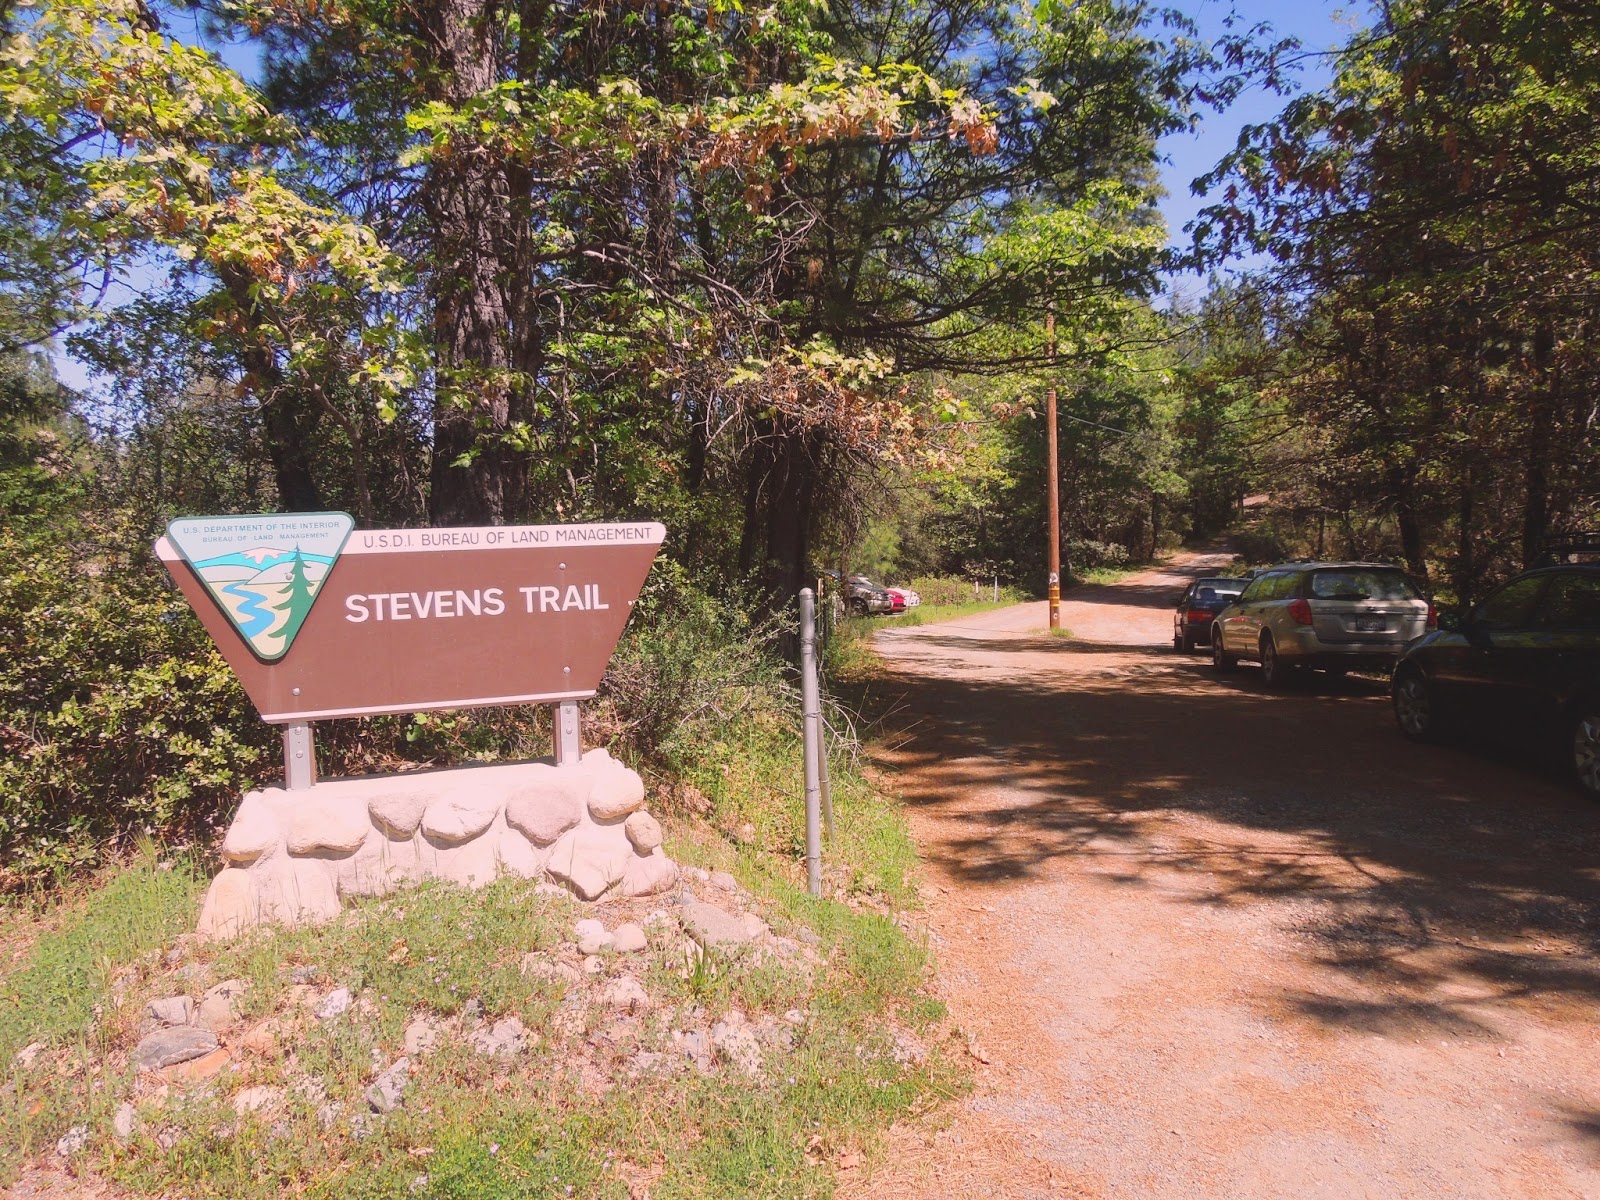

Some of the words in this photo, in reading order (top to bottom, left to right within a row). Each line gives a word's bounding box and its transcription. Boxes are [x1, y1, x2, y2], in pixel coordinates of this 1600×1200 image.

[183, 526, 201, 535] U.S.
[203, 524, 264, 534] DEPARTMENT
[266, 523, 278, 531] OF
[280, 522, 298, 531] THE
[299, 521, 341, 530] INTERIOR
[279, 532, 329, 540] MANAGEMENT
[363, 534, 415, 549] U.S.D.I.
[420, 532, 480, 546] BUREAU
[486, 531, 505, 544] OF
[511, 530, 549, 544] LAND
[555, 527, 653, 542] MANAGEMENT
[345, 587, 506, 623] STEVENS
[519, 584, 610, 614] TRAIL
